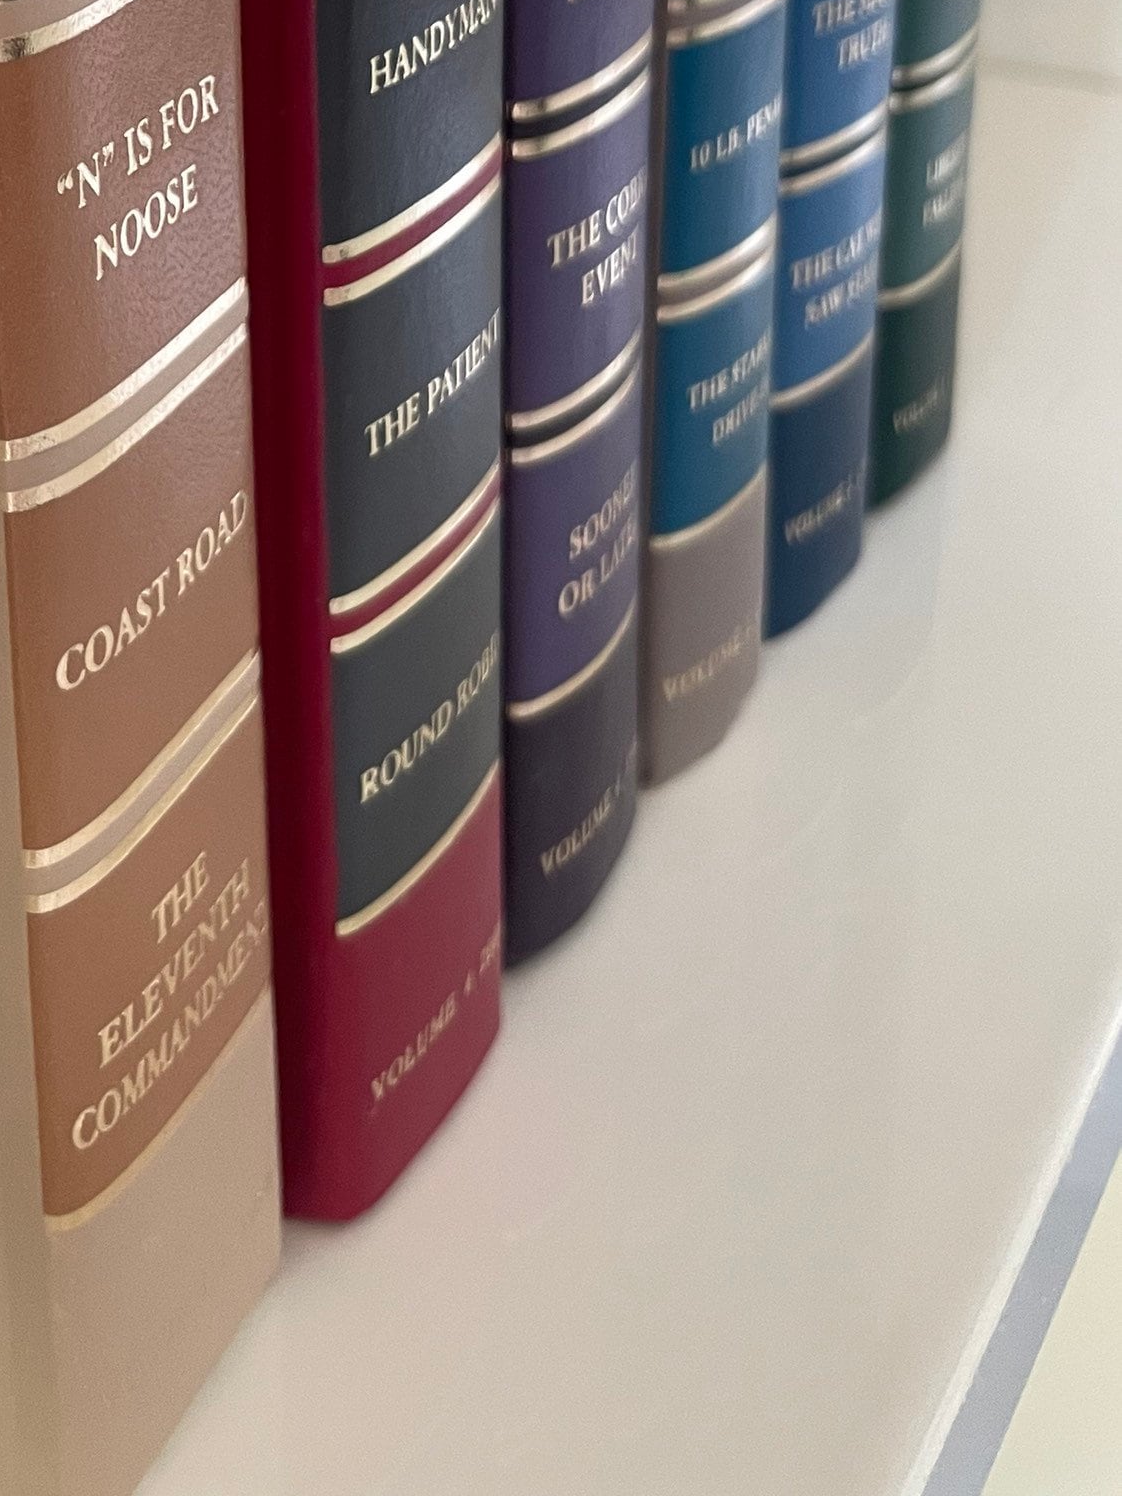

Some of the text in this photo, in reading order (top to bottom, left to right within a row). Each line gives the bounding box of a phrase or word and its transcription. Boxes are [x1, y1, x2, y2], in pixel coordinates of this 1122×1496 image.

[124, 117, 152, 175] IS
[159, 75, 219, 150] FOR
[94, 164, 198, 281] NOOSE
[547, 208, 602, 269] THE
[581, 224, 639, 306] EVENT
[364, 307, 500, 457] THE PATIENT
[56, 490, 247, 690] COAST ROAD
[360, 699, 454, 803] ROUND
[152, 851, 210, 944] THE
[98, 857, 250, 1069] ELEVENTH
[371, 991, 458, 1102] VOLUME
